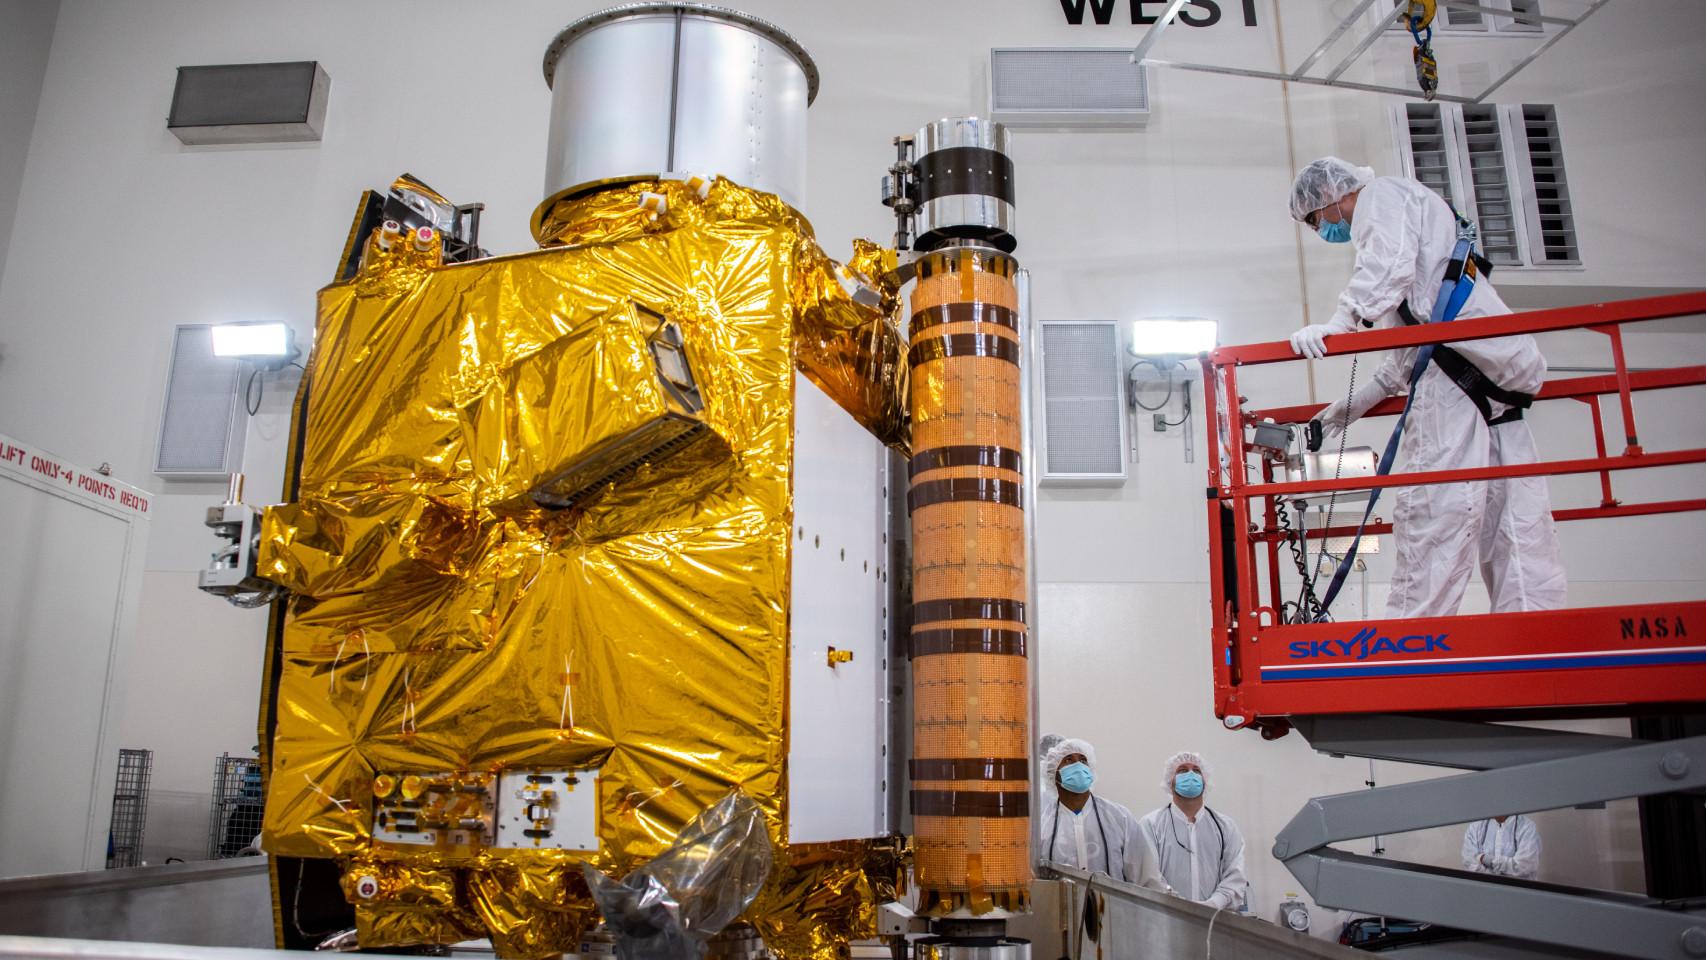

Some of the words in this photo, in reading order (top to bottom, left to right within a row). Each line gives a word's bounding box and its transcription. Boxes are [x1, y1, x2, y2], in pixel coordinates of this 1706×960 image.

[0, 442, 26, 465] LIFT
[78, 474, 115, 500] POINTS
[120, 491, 148, 512] REQ'D
[1289, 627, 1451, 660] SKYJACK
[1620, 616, 1687, 639] NASA
